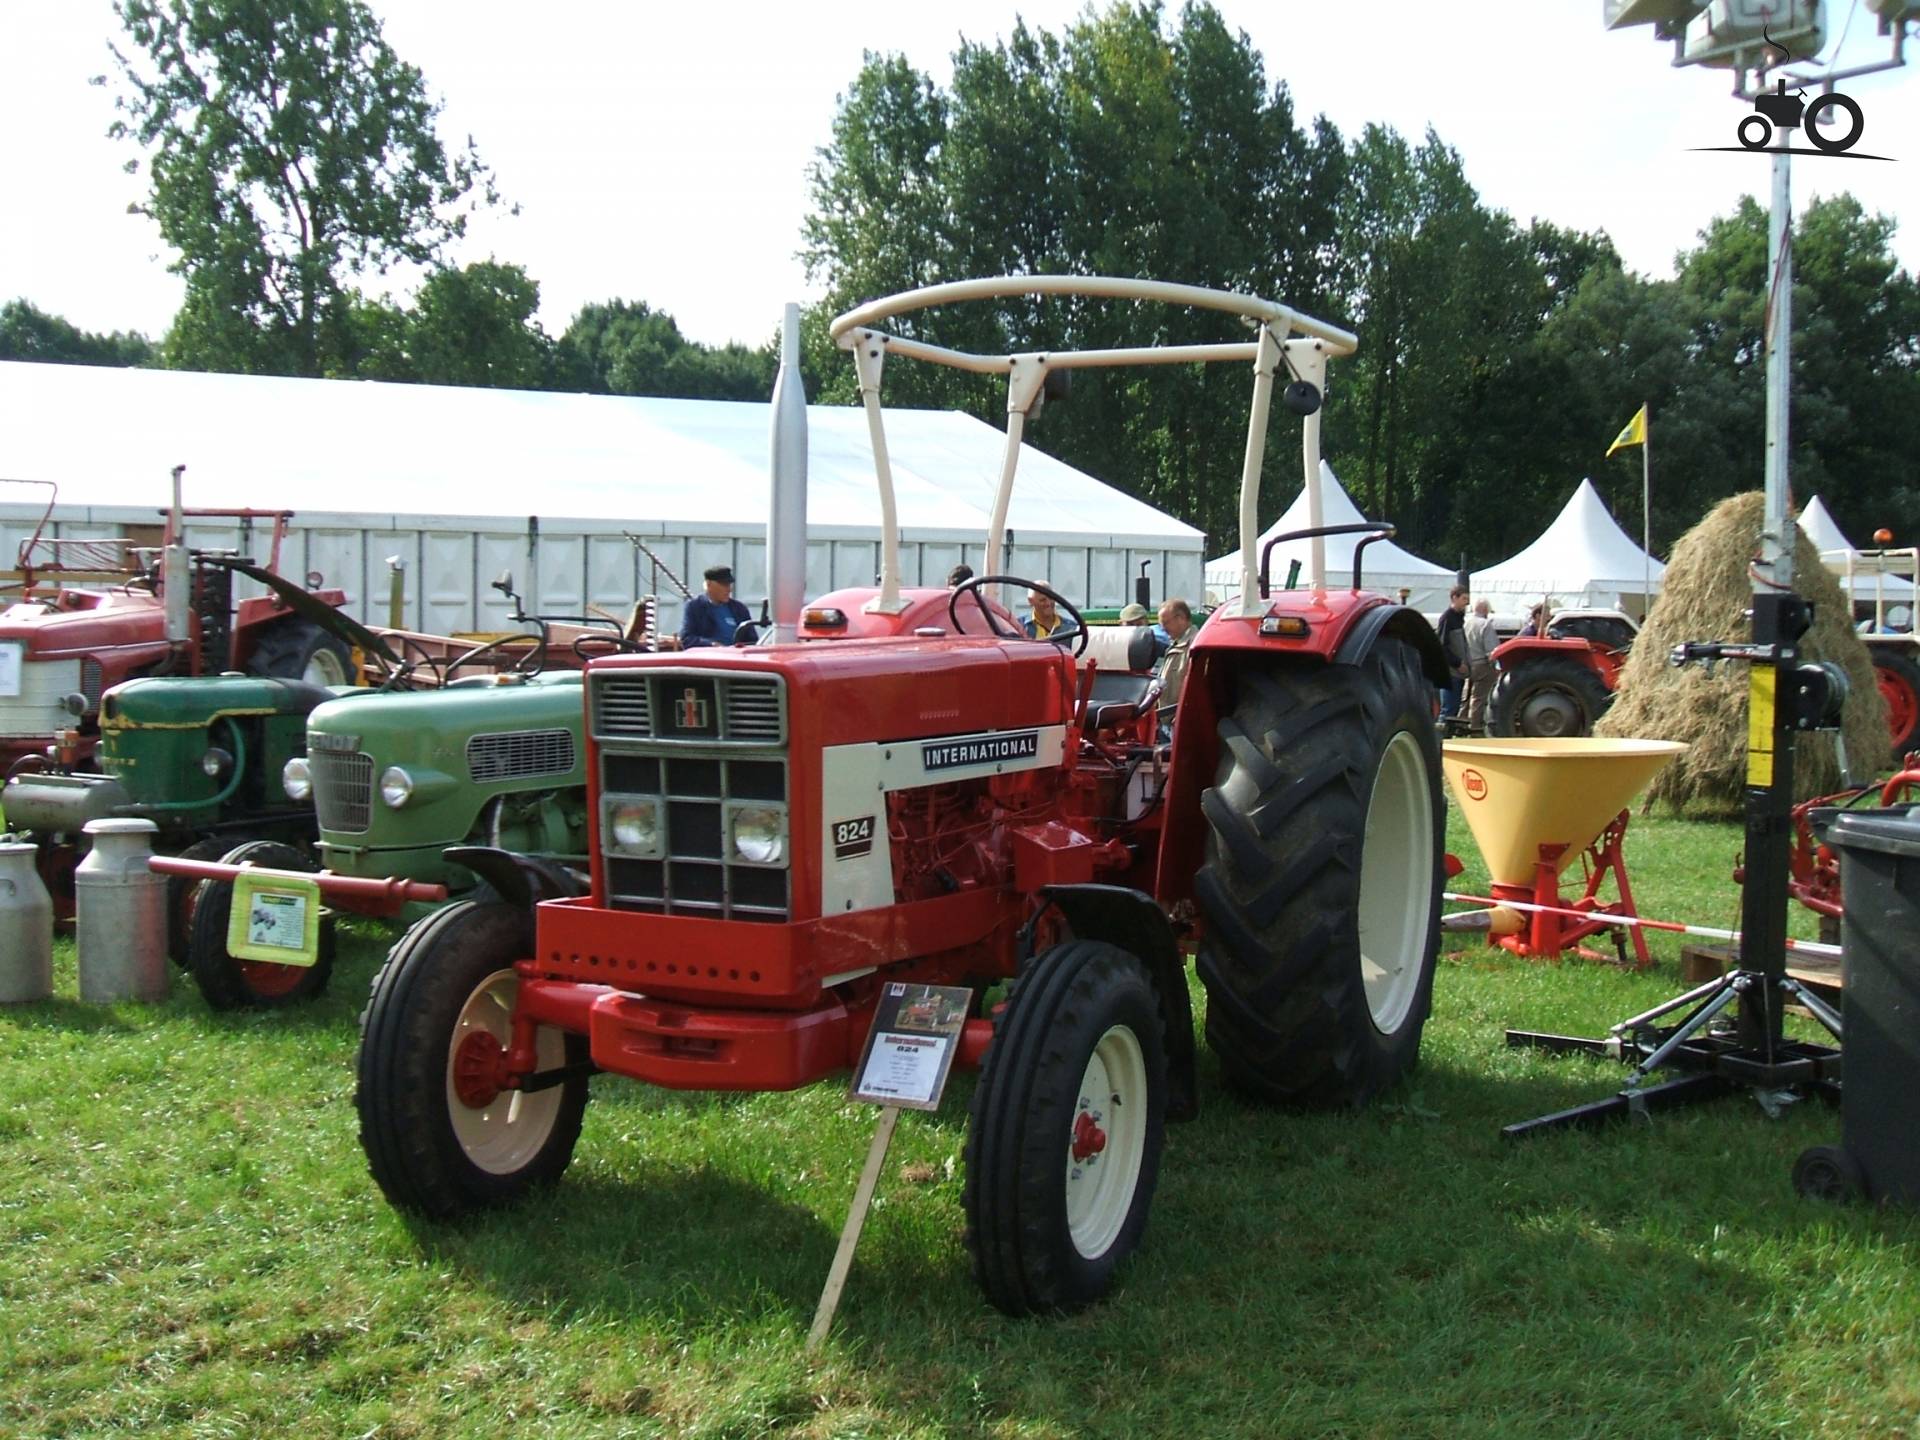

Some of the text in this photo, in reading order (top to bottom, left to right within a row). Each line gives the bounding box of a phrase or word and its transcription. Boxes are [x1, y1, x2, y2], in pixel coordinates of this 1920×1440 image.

[925, 738, 1036, 766] INTERNATIONAL
[837, 819, 870, 844] 824
[896, 1045, 919, 1053] 824
